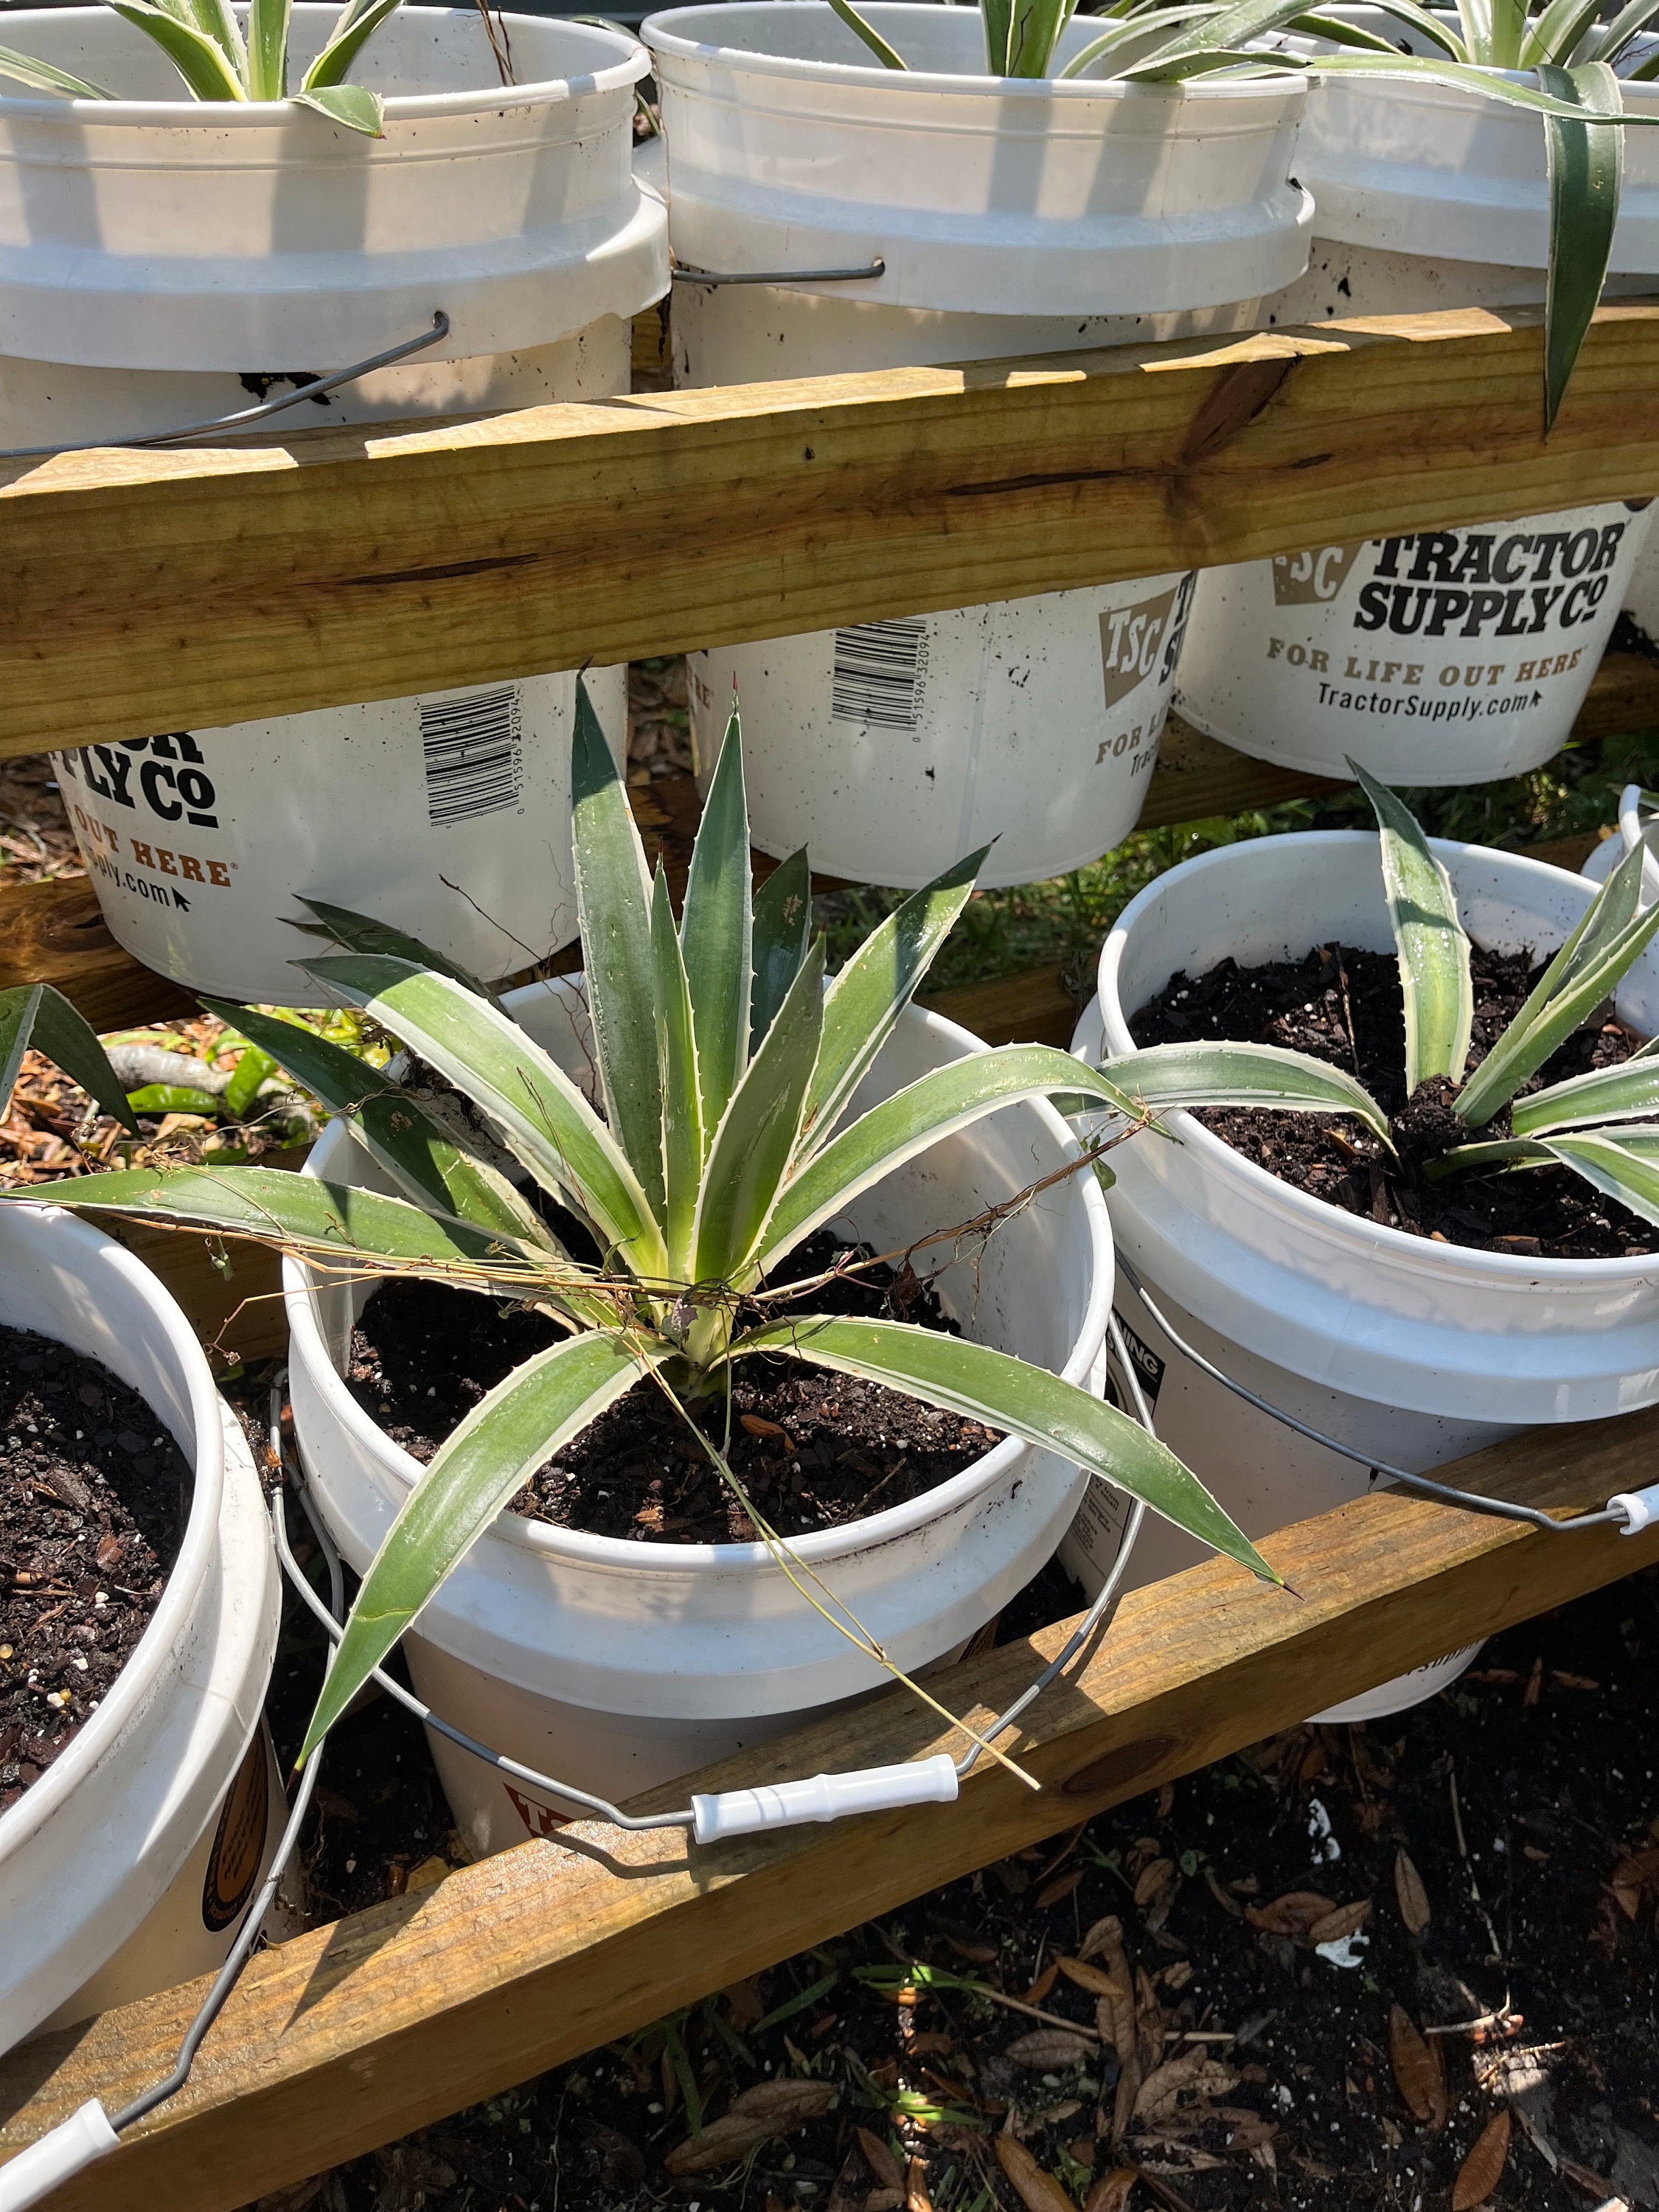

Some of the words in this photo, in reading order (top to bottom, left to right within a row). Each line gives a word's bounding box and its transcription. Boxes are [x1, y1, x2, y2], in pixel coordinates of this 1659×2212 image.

[1275, 546, 1344, 599] SC
[1372, 523, 1625, 584] TRACTOR
[1106, 609, 1161, 676] TSC
[1267, 637, 1329, 672] FOR
[1344, 657, 1424, 684] LIFE
[1439, 665, 1505, 686] OUT
[1318, 682, 1528, 722] TractorSupply.com
[1095, 726, 1142, 765] FOR
[74, 804, 119, 852] OUT
